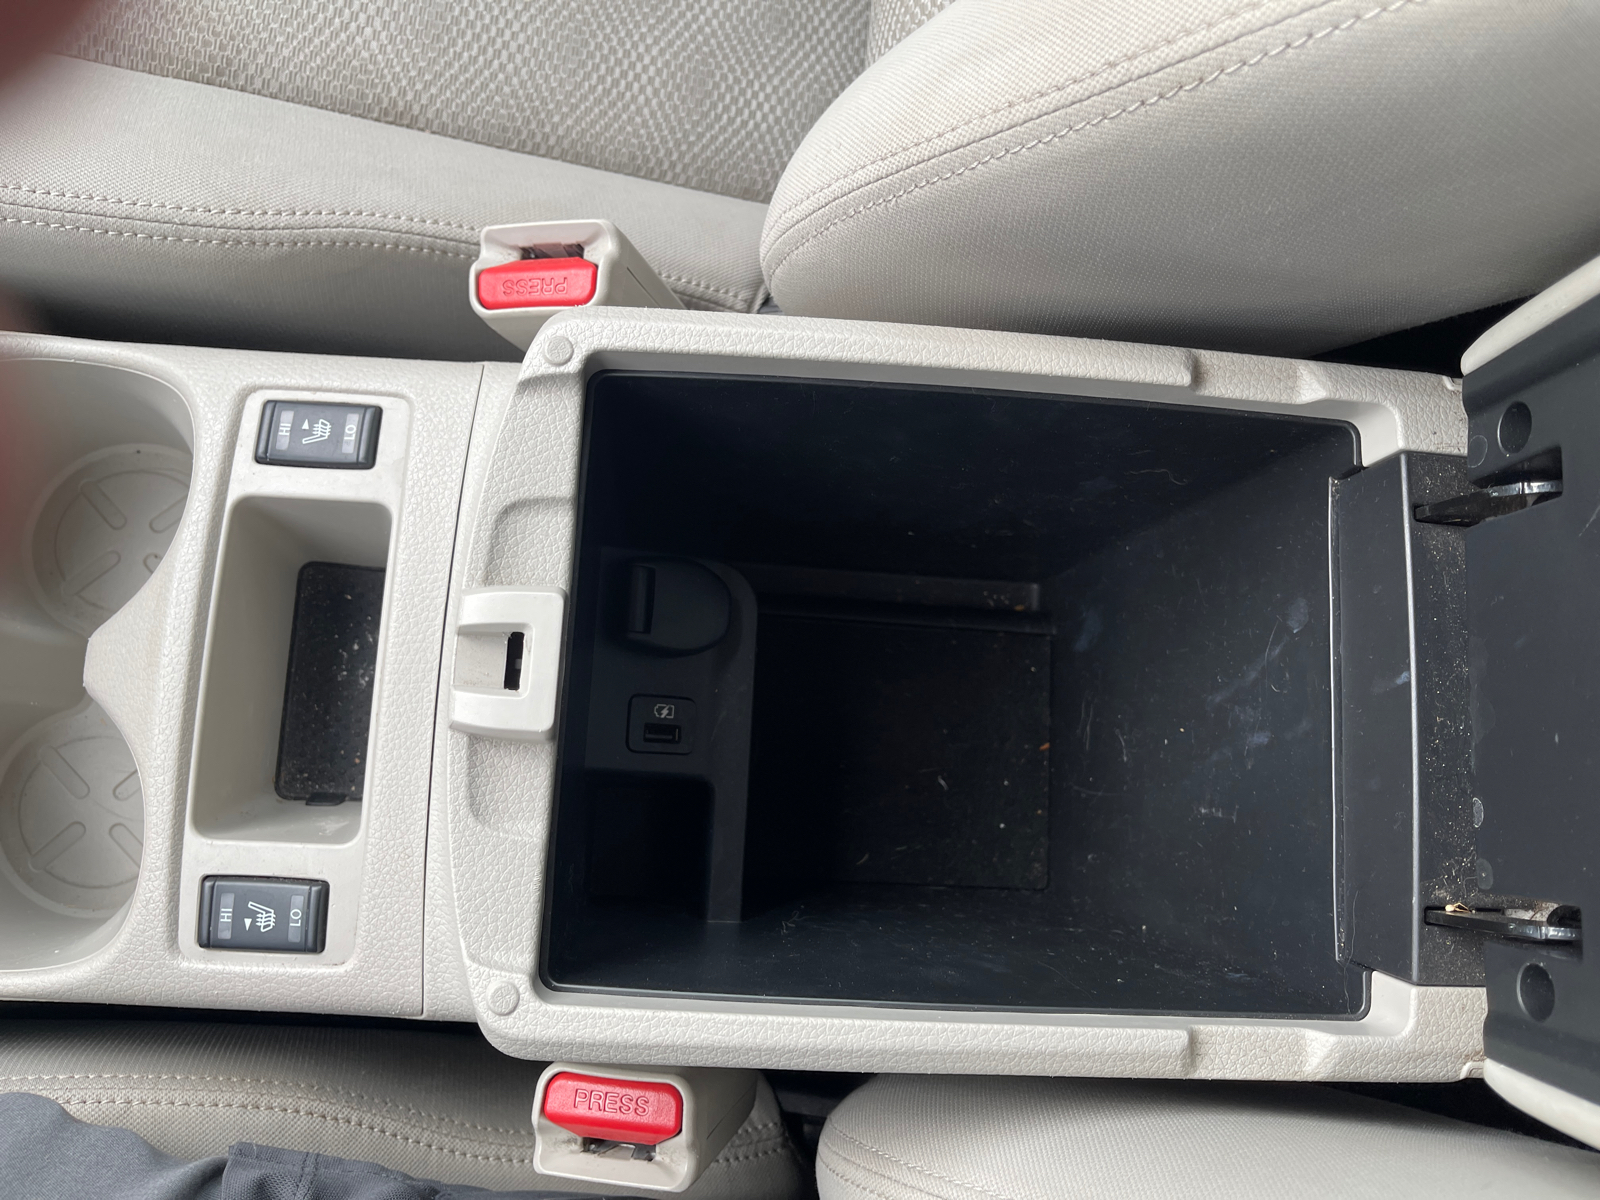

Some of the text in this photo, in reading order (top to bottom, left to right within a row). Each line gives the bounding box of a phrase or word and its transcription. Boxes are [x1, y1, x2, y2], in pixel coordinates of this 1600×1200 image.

[502, 276, 569, 297] PRESS
[278, 423, 292, 436] HI
[343, 424, 357, 440] LO
[220, 908, 233, 922] HI
[289, 908, 302, 927] LO
[573, 1088, 650, 1117] PRESS
